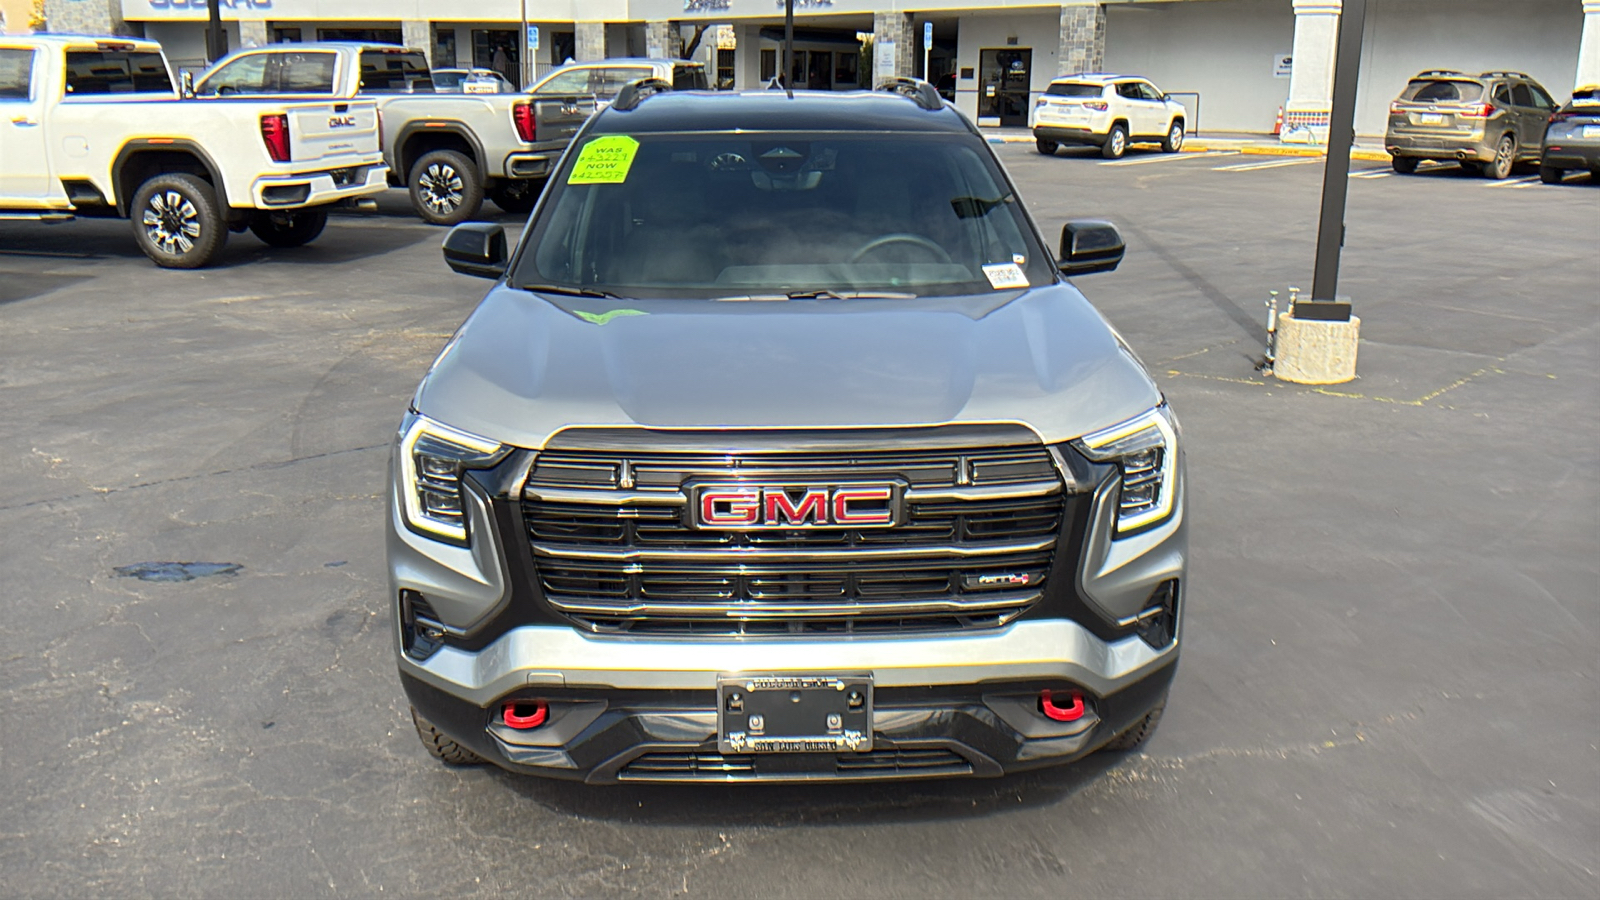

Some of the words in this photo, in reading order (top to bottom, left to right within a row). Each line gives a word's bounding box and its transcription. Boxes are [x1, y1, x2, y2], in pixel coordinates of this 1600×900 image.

[329, 116, 356, 128] GMC
[701, 488, 892, 525] GMC
[979, 573, 1029, 585] AT4
[754, 740, 774, 751] SAN
[779, 740, 801, 751] LUIS
[804, 740, 838, 751] OBISPO
